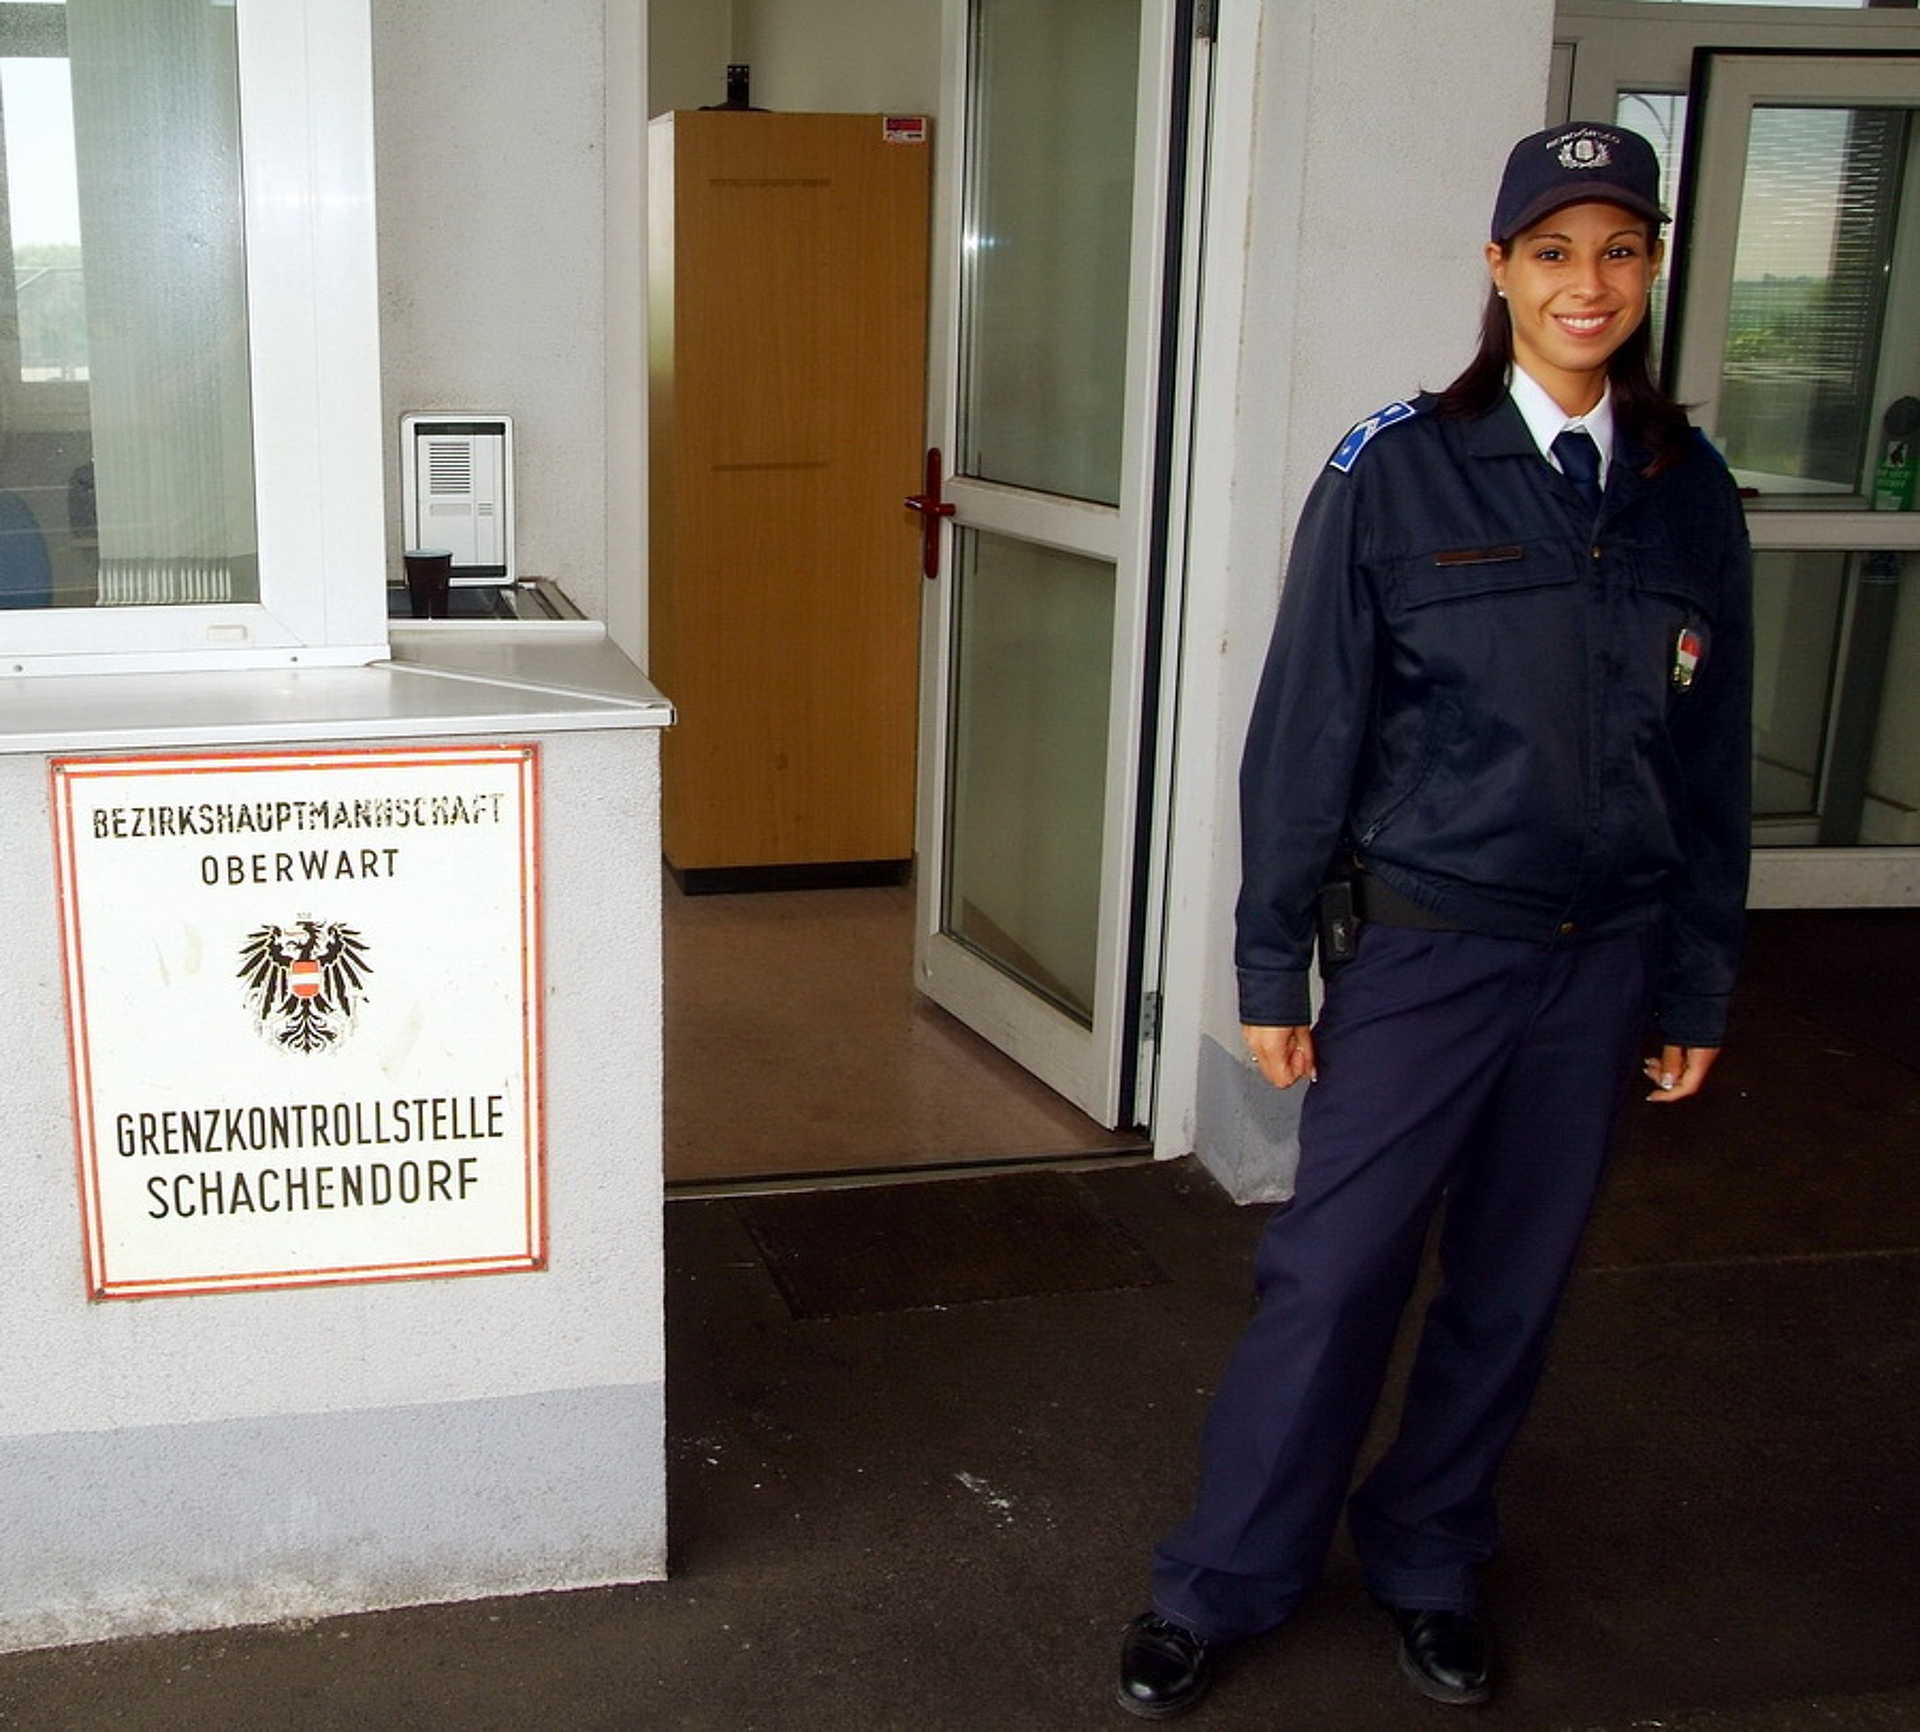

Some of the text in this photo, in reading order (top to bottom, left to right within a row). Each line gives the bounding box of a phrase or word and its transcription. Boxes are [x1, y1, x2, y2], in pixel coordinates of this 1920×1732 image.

[93, 793, 505, 839] BEZIRKSHAUPTMANNSCHAFT
[201, 849, 399, 885] OBERWART
[116, 1096, 504, 1156] GRENZKONTROLLSTELLE
[147, 1158, 478, 1219] SCHACHENDORF
